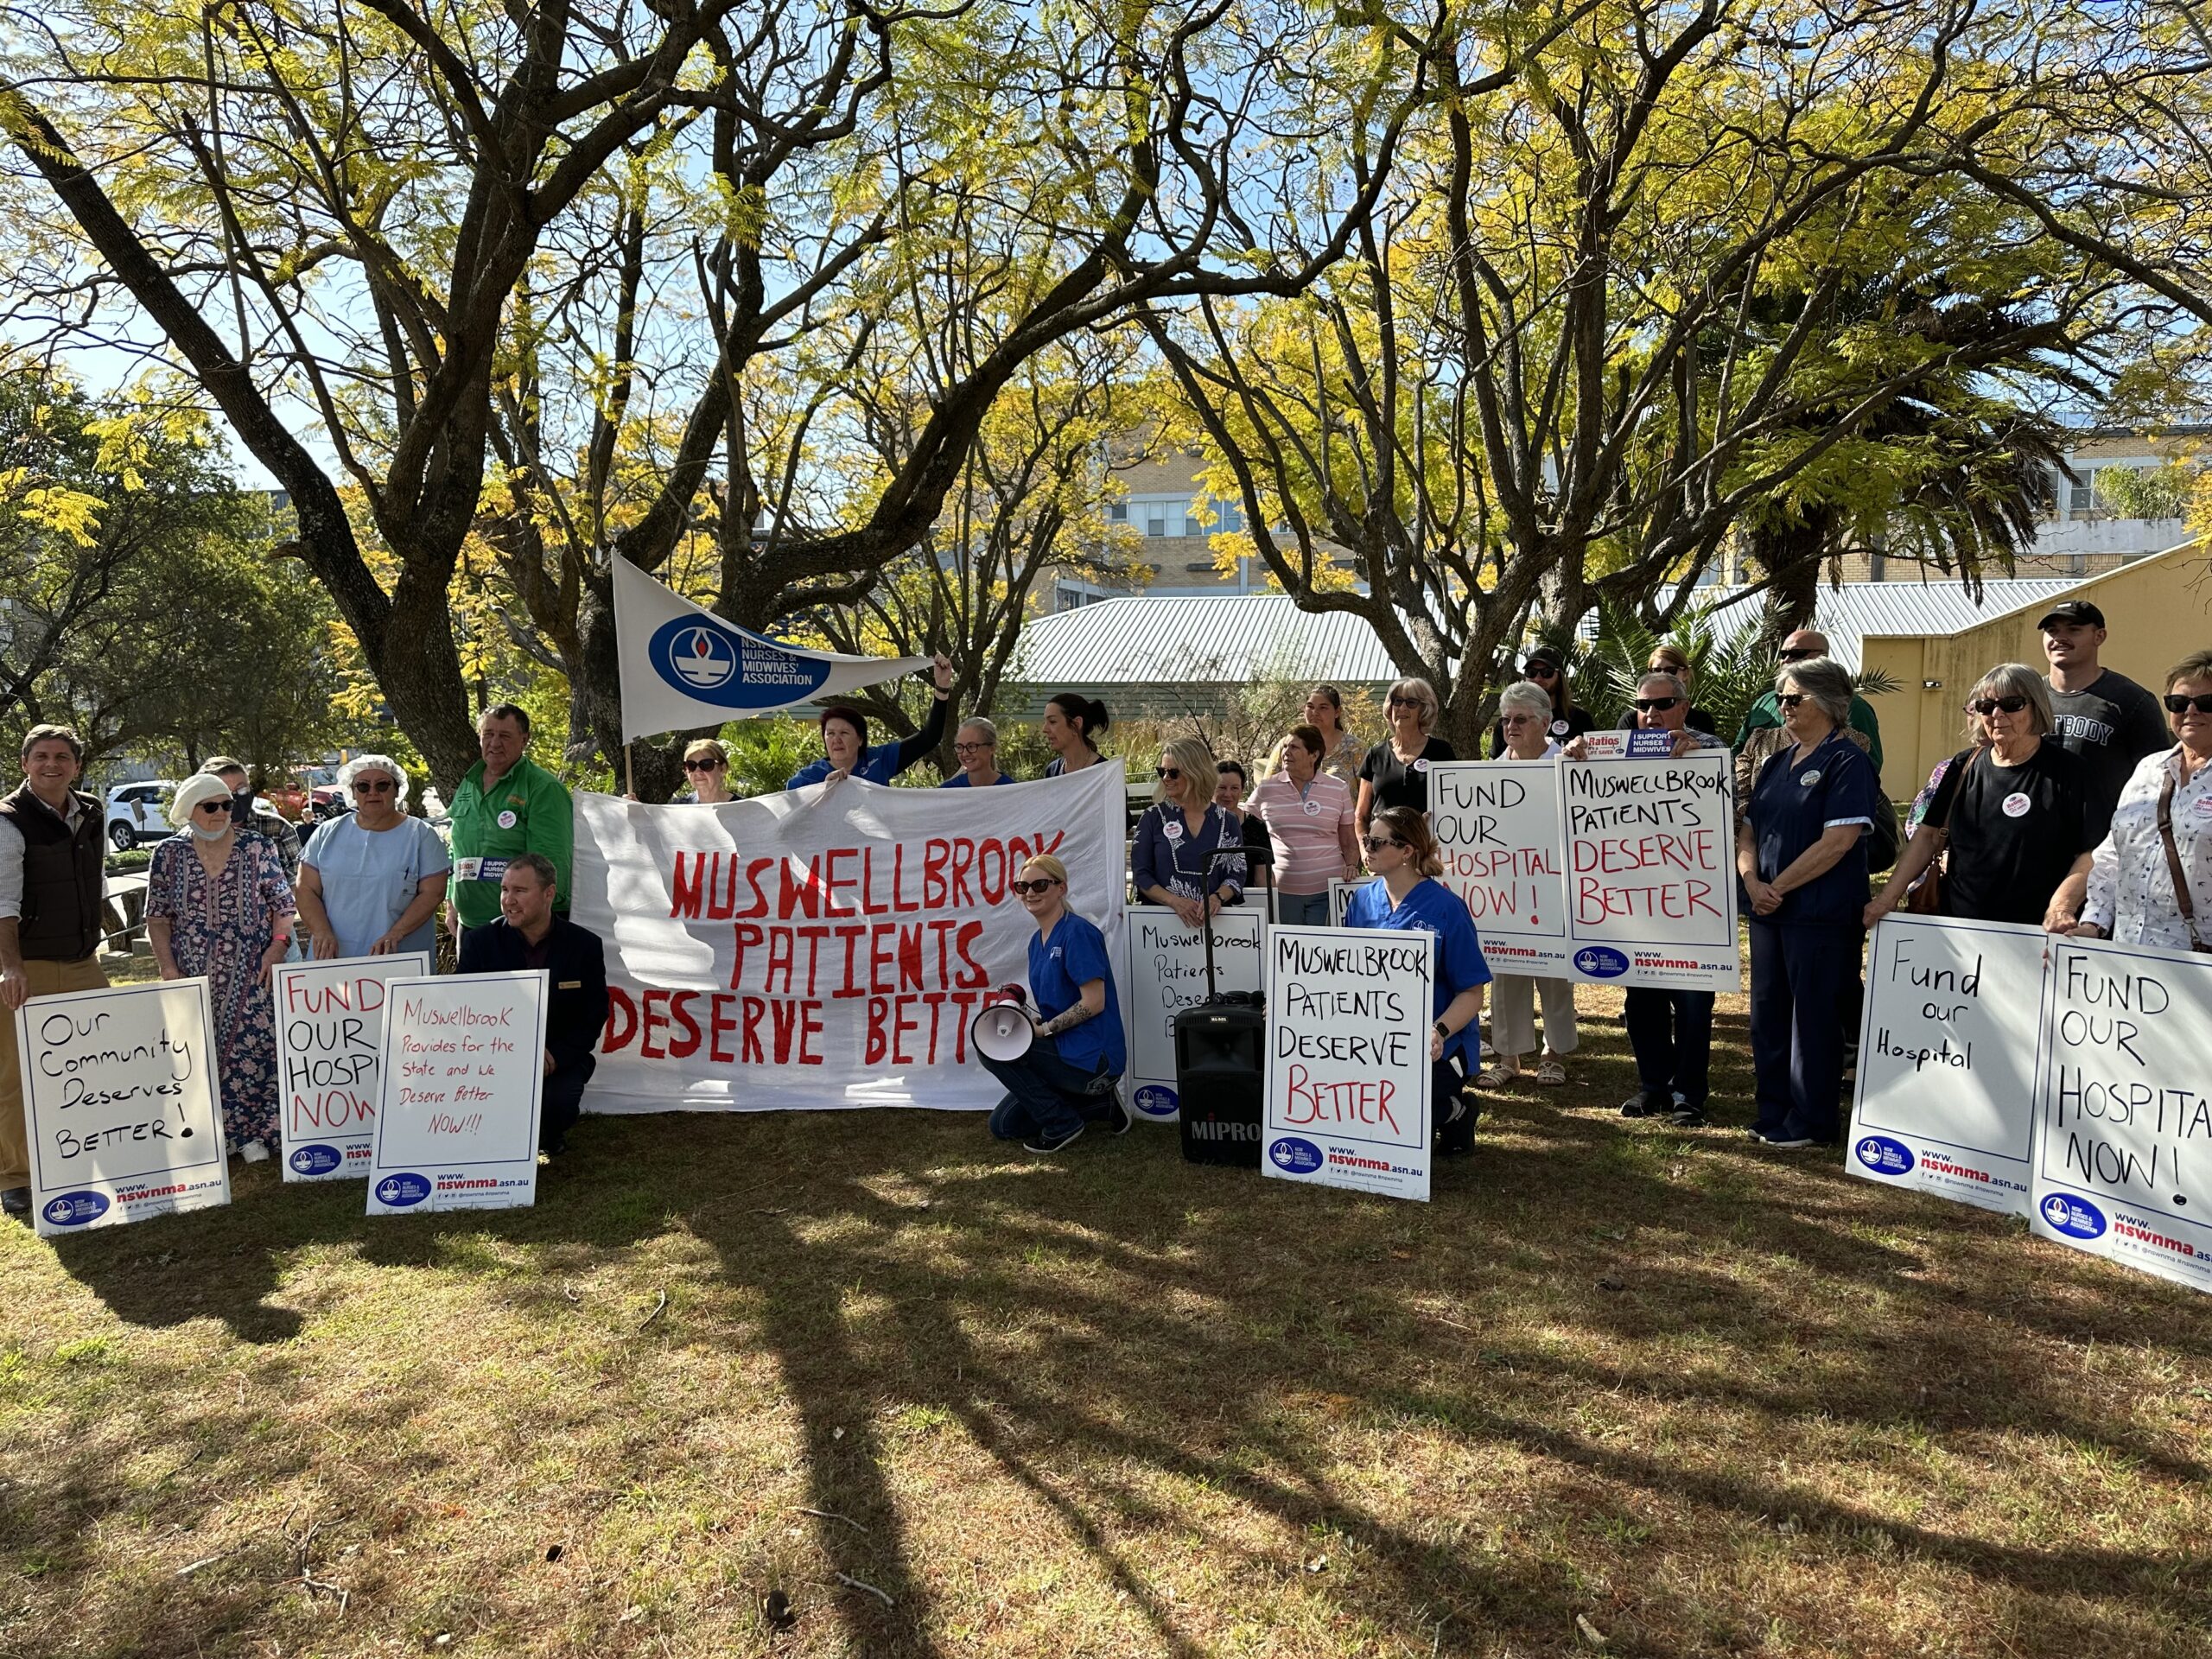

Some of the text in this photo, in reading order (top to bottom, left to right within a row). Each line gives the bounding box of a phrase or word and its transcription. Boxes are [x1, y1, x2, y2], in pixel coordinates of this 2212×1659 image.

[741, 649, 797, 662] NURSES &
[742, 661, 798, 673] MIDWIVES'
[742, 673, 812, 685] ASSOCIATION
[1589, 736, 1619, 746] Ratios
[1440, 772, 1526, 809] FUND
[1437, 816, 1508, 846] OUR
[1571, 798, 1701, 835] PATIENTS
[1438, 848, 1561, 877] HOSPITAL
[1574, 830, 1717, 874] DESERVE
[1575, 877, 1722, 925] BETTER
[1141, 925, 1262, 950] Muswelbrook
[1484, 945, 1565, 959] nswnma.asn.au
[730, 919, 990, 999] PATIENTS
[1154, 954, 1224, 982] Patiens
[1279, 938, 1430, 983] MUSWELLBROOK
[1635, 957, 1732, 971] nswnma.asn.au
[1892, 938, 1982, 997] Fund
[287, 975, 385, 1014] FUND
[2068, 956, 2170, 1014] FUND
[1287, 982, 1404, 1021] PATIENTS
[1922, 1002, 1968, 1022] our
[41, 1014, 110, 1046] Our
[288, 1018, 377, 1052] OUR
[601, 985, 824, 1065] DESERVE
[864, 991, 1001, 1065] BETT
[2061, 1010, 2145, 1066] OUR
[41, 1028, 192, 1081] Community
[402, 1034, 514, 1054] Provides for the
[1279, 1026, 1411, 1067] DESERVE
[1877, 1027, 1971, 1072] Hospital
[288, 1054, 379, 1092] HOSPI
[403, 1059, 435, 1077] State
[447, 1064, 469, 1077] and
[60, 1077, 182, 1109] Deserves
[399, 1085, 494, 1105] Deserve Better
[1284, 1064, 1400, 1135] BETTER
[2058, 1065, 2212, 1139] HOSPITA
[428, 1113, 482, 1135] NOW!!!
[346, 1150, 372, 1159] nsw
[1328, 1146, 1357, 1156] www.
[1328, 1154, 1422, 1177] nswnma.asn.au
[1922, 1148, 1953, 1163] www.
[116, 1182, 149, 1194] www.
[436, 1178, 529, 1190] nswnma.asn.au
[1921, 1157, 2027, 1192] nswnma.asn.au
[117, 1179, 222, 1203] nswnma.asn.au
[2114, 1212, 2151, 1230] www.
[2114, 1221, 2212, 1263] nswnma.as
[2142, 1247, 2211, 1274] @nswnma #nswnma
